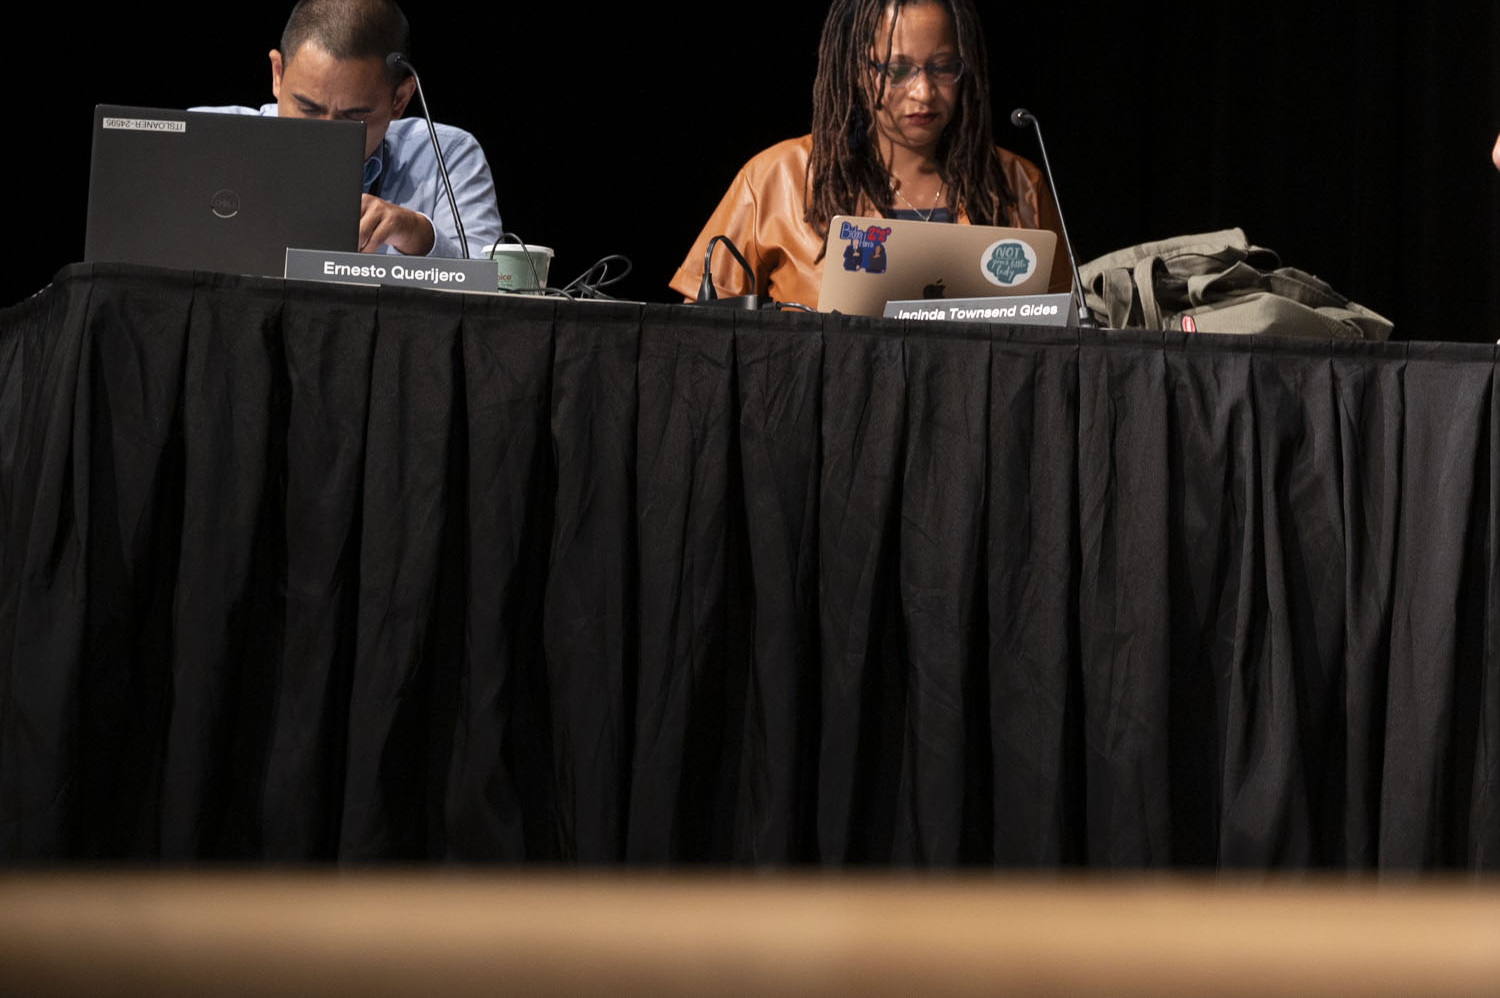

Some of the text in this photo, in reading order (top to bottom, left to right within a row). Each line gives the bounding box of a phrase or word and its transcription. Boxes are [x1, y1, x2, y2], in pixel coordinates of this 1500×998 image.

[323, 261, 466, 284] Ernesto Querijero
[950, 305, 1016, 320] Townsend
[1019, 304, 1058, 317] Gides
